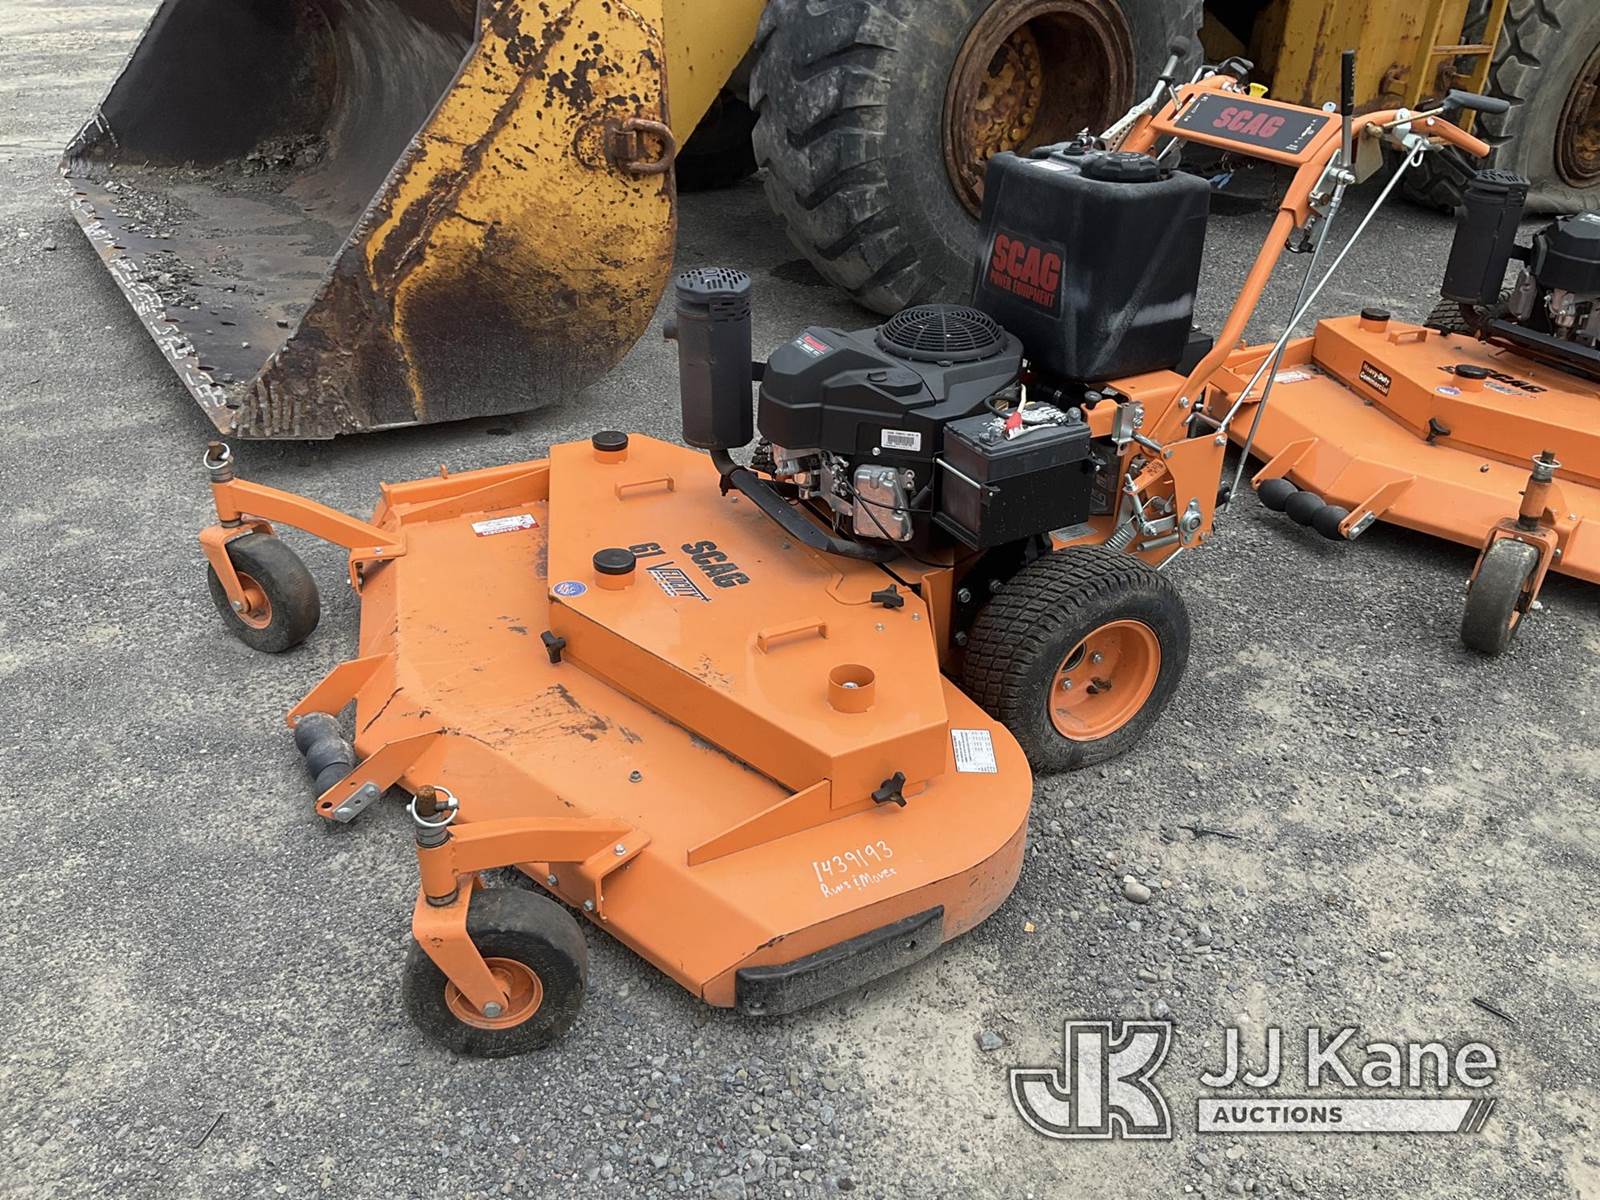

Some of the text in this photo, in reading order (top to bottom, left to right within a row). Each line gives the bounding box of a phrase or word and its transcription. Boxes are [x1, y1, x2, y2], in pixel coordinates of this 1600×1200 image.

[1212, 106, 1286, 138] SCAG
[991, 233, 1061, 292] SCAG
[1012, 279, 1056, 308] EQUIPMENT
[629, 542, 666, 558] 61
[681, 540, 751, 588] SCAG
[812, 841, 893, 883] 1439193
